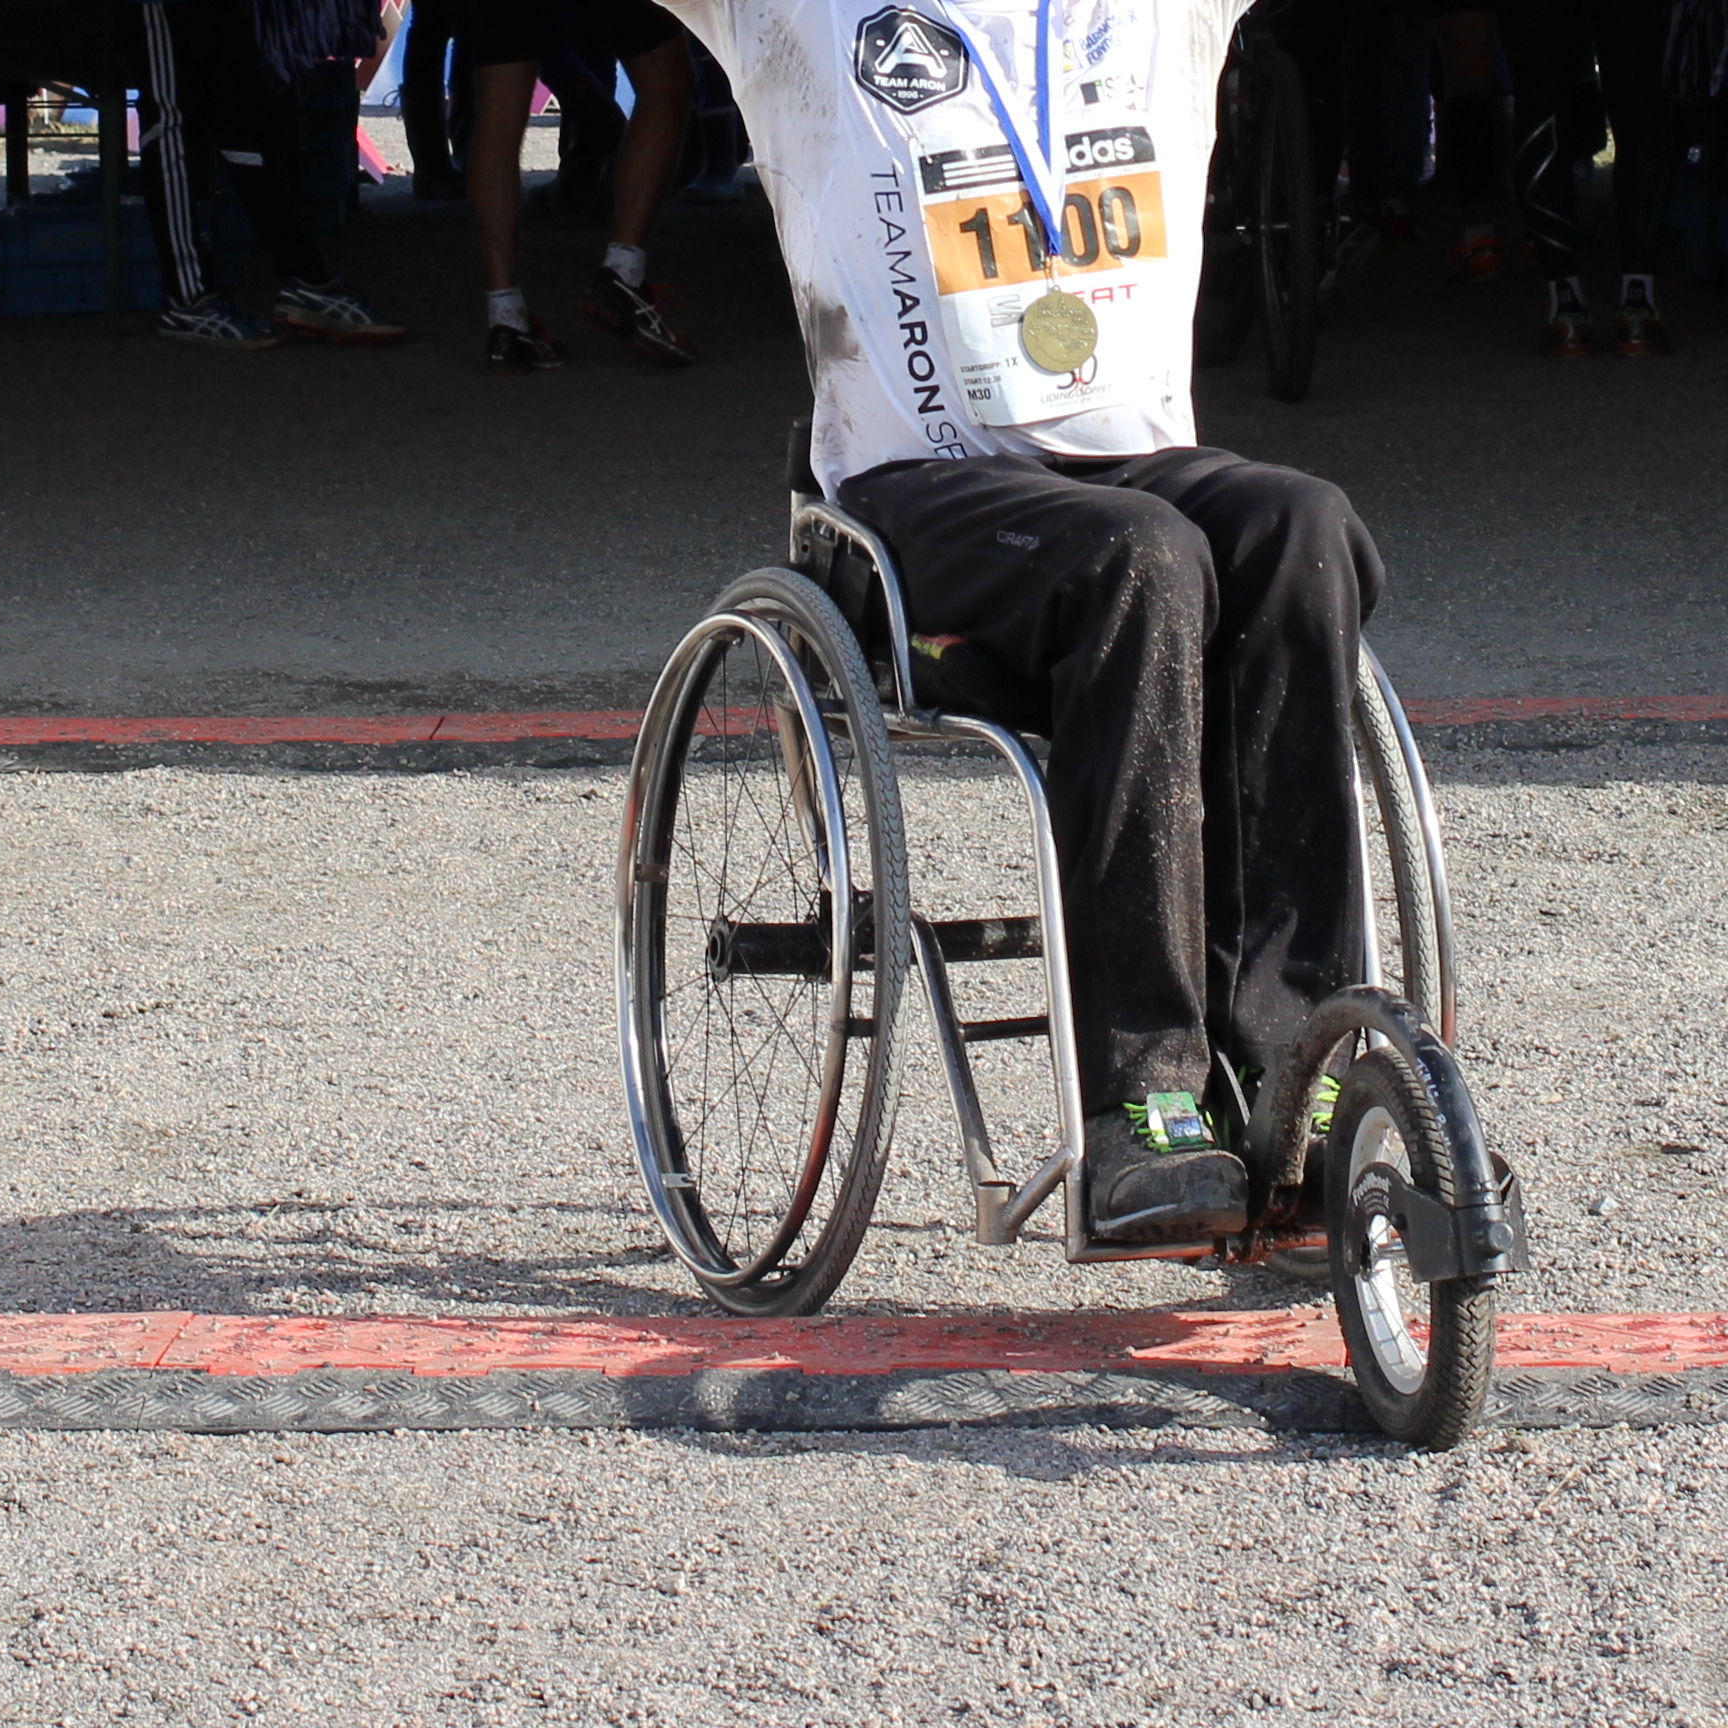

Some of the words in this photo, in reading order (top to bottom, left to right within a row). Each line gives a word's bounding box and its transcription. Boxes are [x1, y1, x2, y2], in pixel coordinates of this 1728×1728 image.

[873, 75, 909, 88] TEAM
[910, 78, 946, 91] ARON
[959, 186, 1141, 280] 1100
[967, 388, 991, 400] M30
